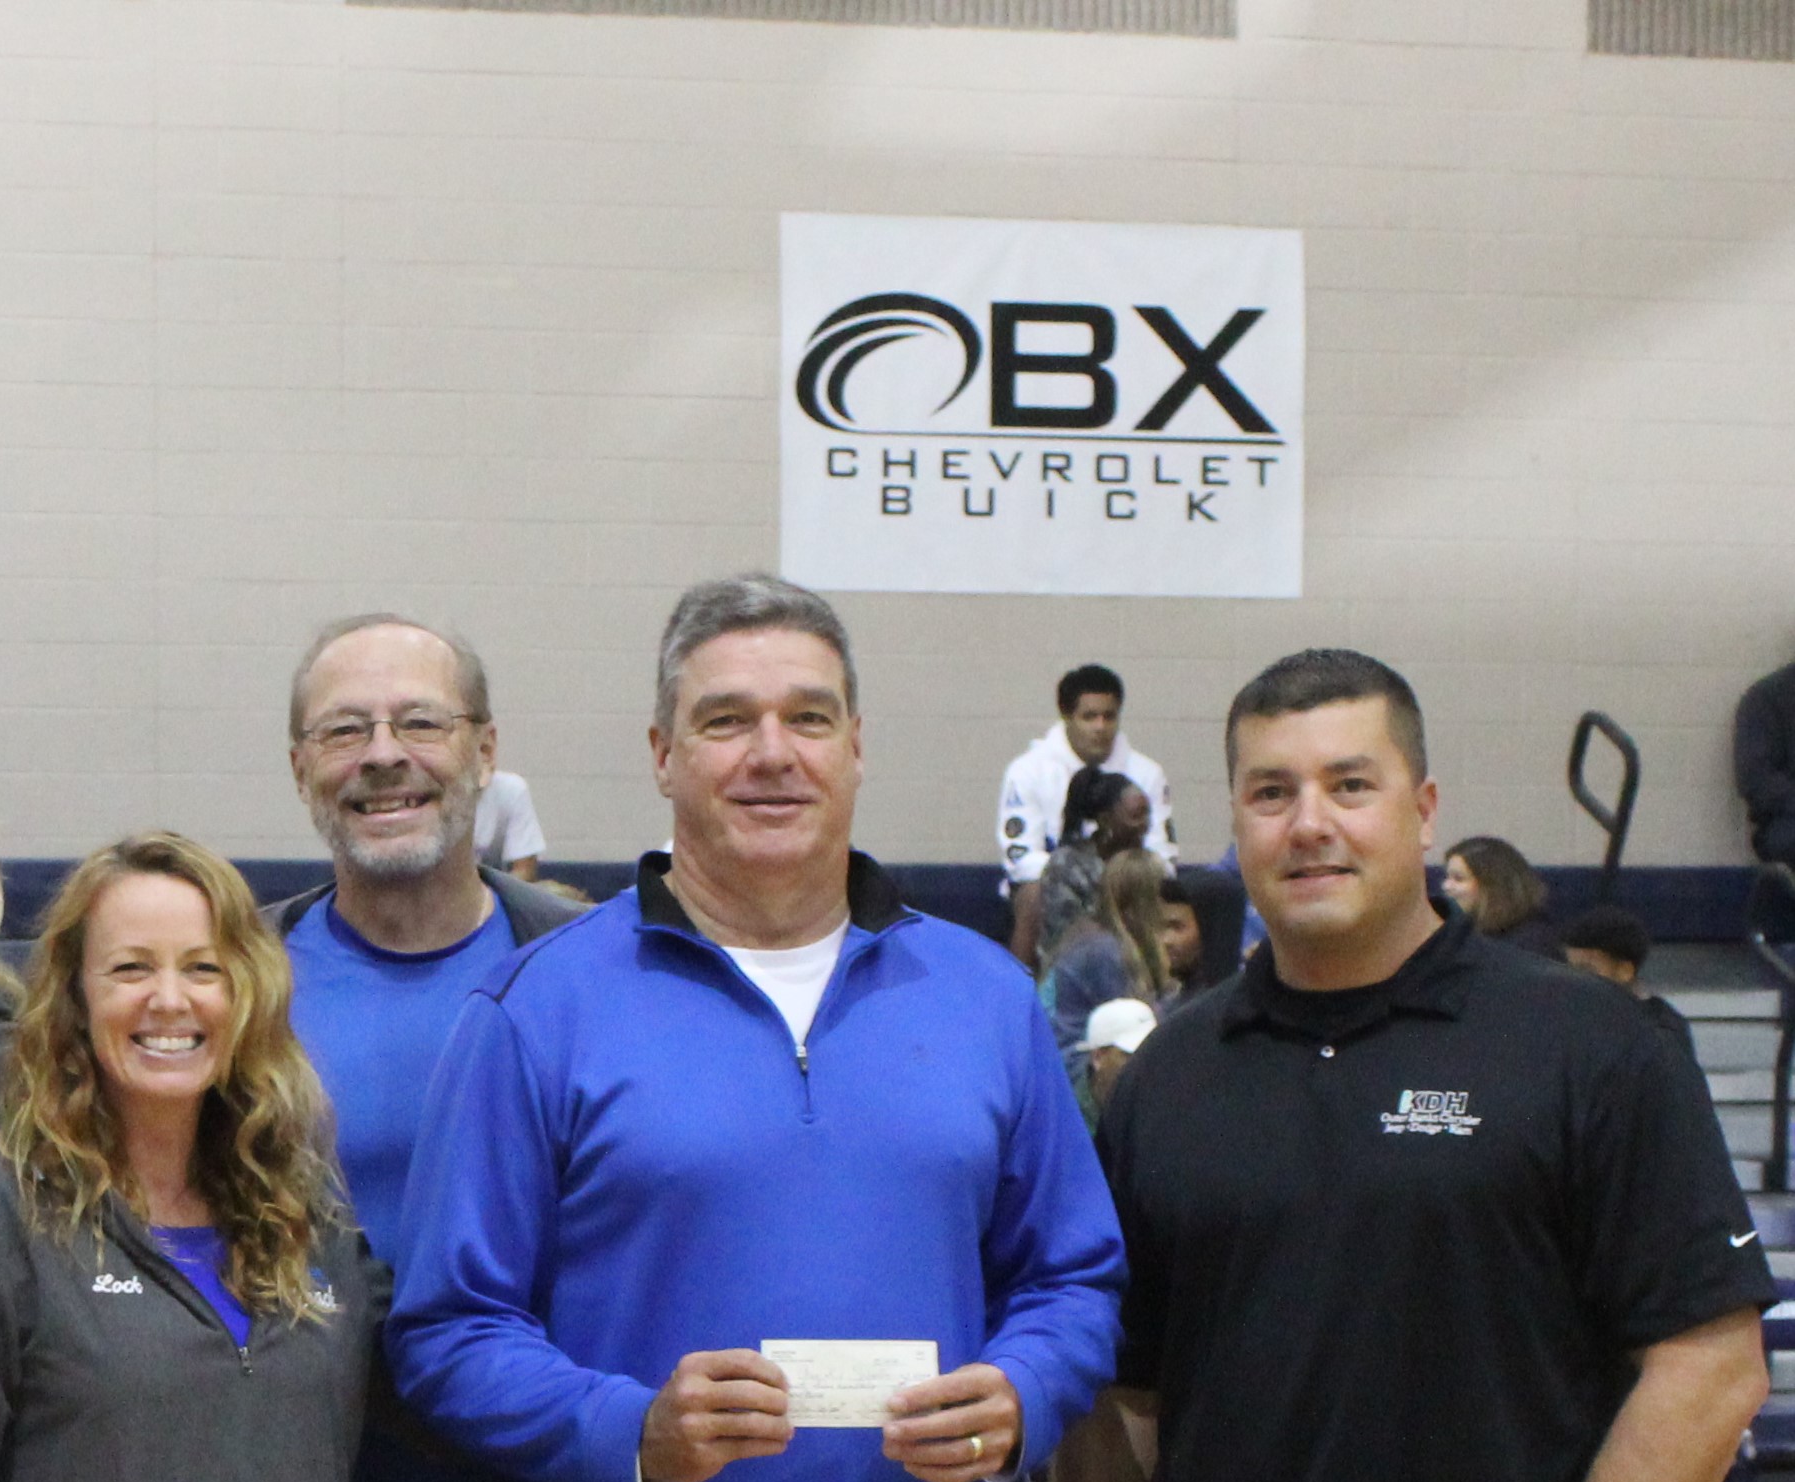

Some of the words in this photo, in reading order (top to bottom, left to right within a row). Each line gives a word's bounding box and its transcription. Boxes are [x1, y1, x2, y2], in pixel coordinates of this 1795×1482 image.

[826, 447, 1279, 487] CHEVROLET
[881, 485, 1219, 522] BUICK
[1398, 1089, 1469, 1114] KDH
